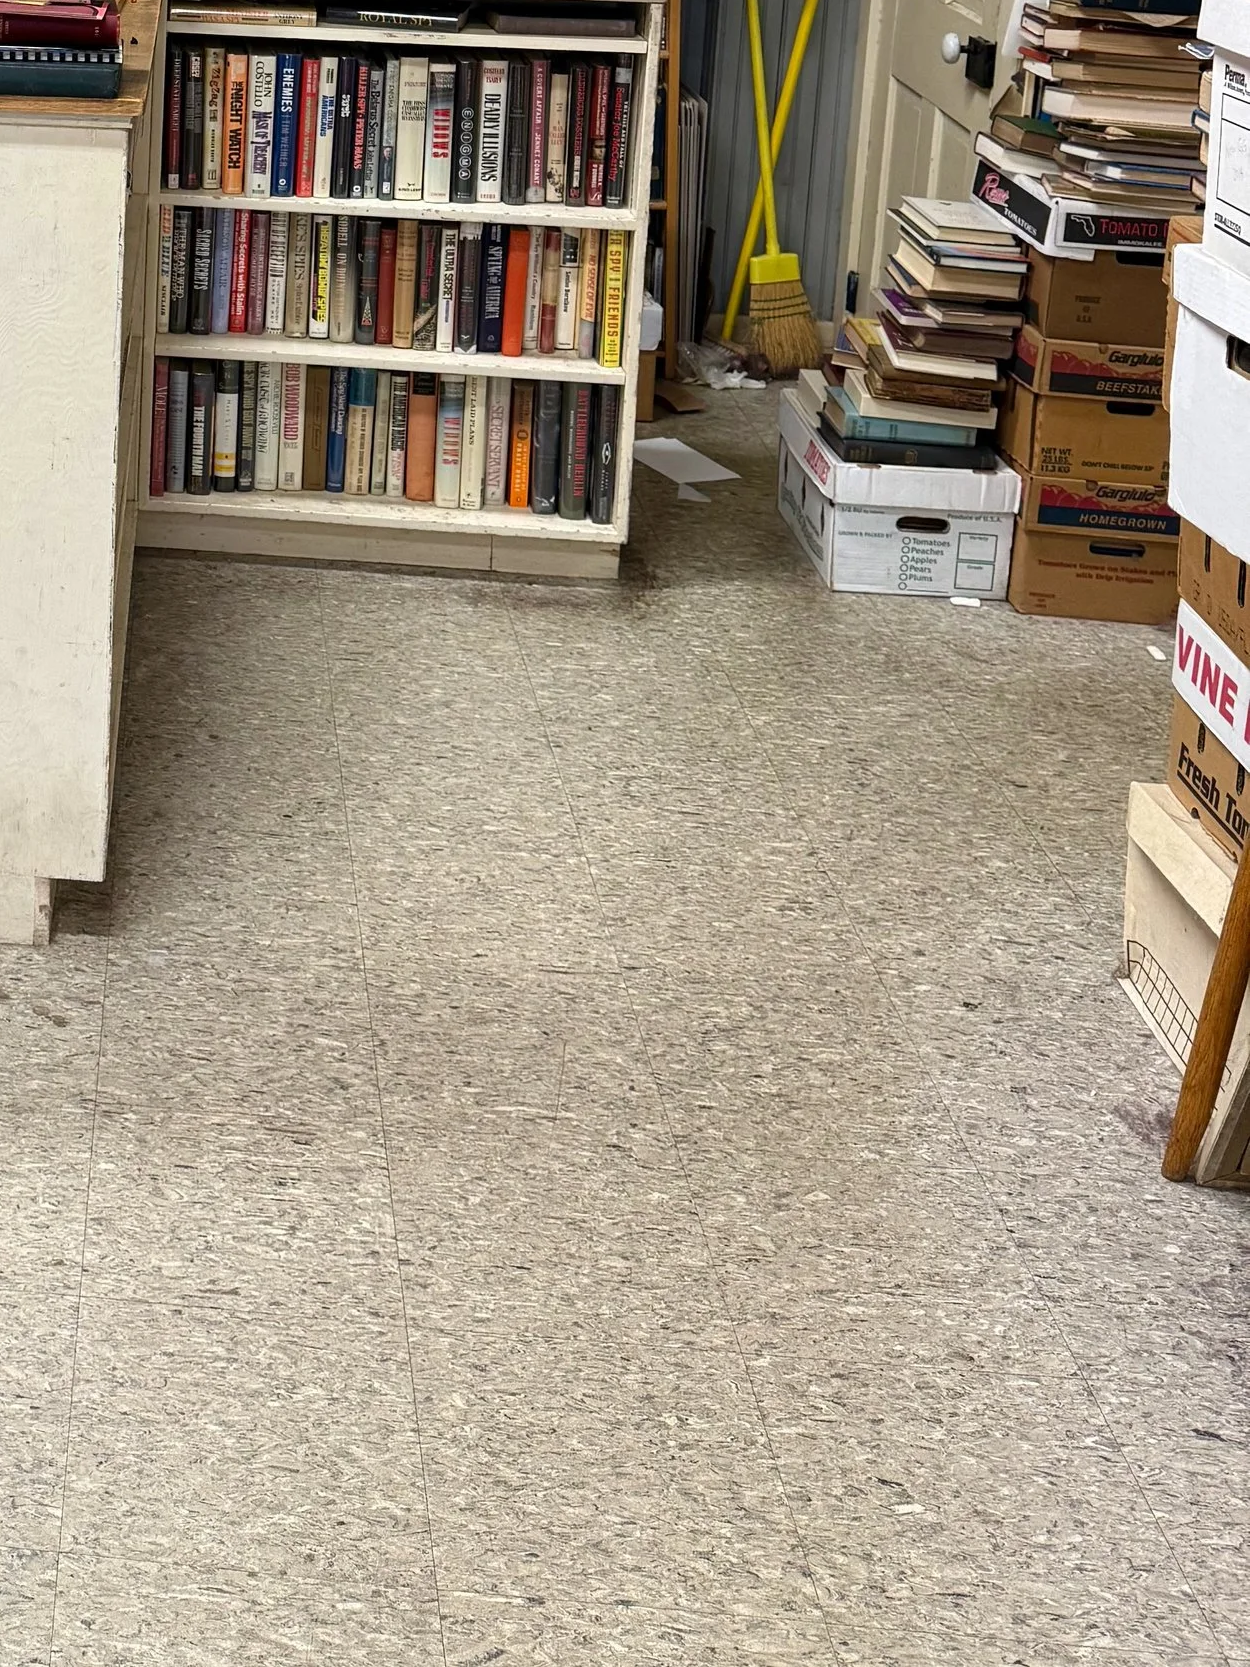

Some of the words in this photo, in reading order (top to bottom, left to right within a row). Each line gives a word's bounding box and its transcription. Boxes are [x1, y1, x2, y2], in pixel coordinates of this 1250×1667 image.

[360, 13, 404, 25] ROYAL
[254, 61, 265, 107] COSTELLO
[263, 72, 272, 98] JOHN
[281, 69, 295, 112] ENEMIES
[358, 66, 367, 97] KILLER
[230, 88, 242, 125] NIGHT
[369, 91, 380, 120] Belarus
[484, 94, 502, 130] DEADLY
[615, 87, 624, 120] Senator
[355, 119, 365, 146] PETER
[368, 122, 378, 148] Secret
[613, 122, 622, 137] Joe
[228, 128, 241, 169] WATCH
[353, 147, 362, 170] MAAS
[481, 133, 499, 182] ILLUSIONS
[608, 138, 620, 182] McCarthy
[238, 213, 249, 242] Sharing
[337, 216, 348, 248] SOBELL
[1004, 207, 1038, 237] TOMATOES
[1101, 218, 1158, 237] TOMATO
[195, 229, 212, 257] SACRED
[446, 233, 456, 247] THE
[238, 244, 247, 273] Secrets
[337, 253, 347, 265] ON
[444, 249, 455, 272] ULTRA
[609, 251, 621, 273] SPY
[194, 259, 210, 290] SECRETS
[442, 274, 454, 301] SECRET
[587, 267, 596, 290] SENSE
[585, 302, 594, 319] EVIL
[586, 291, 595, 301] OF
[607, 287, 620, 336] FRIENDS
[285, 363, 301, 382] BOB
[1109, 351, 1164, 367] Gargiulo
[193, 406, 205, 422] THE
[283, 384, 300, 440] WOODWARD
[489, 405, 504, 444] SECRET
[575, 389, 590, 460] BATTLEGROUND
[192, 422, 204, 455] FOURTH
[442, 417, 460, 466] WIDOWS
[191, 456, 203, 476] MAN
[486, 445, 502, 489] SERVANT
[573, 463, 587, 497] BERLIN
[1096, 485, 1155, 502] Gargiulo
[1079, 513, 1167, 531] HOMEGROWN
[911, 547, 944, 557] Peaches
[912, 537, 951, 547] Tomatoes
[1178, 623, 1239, 728] VINE
[1178, 742, 1220, 811] Fresh
